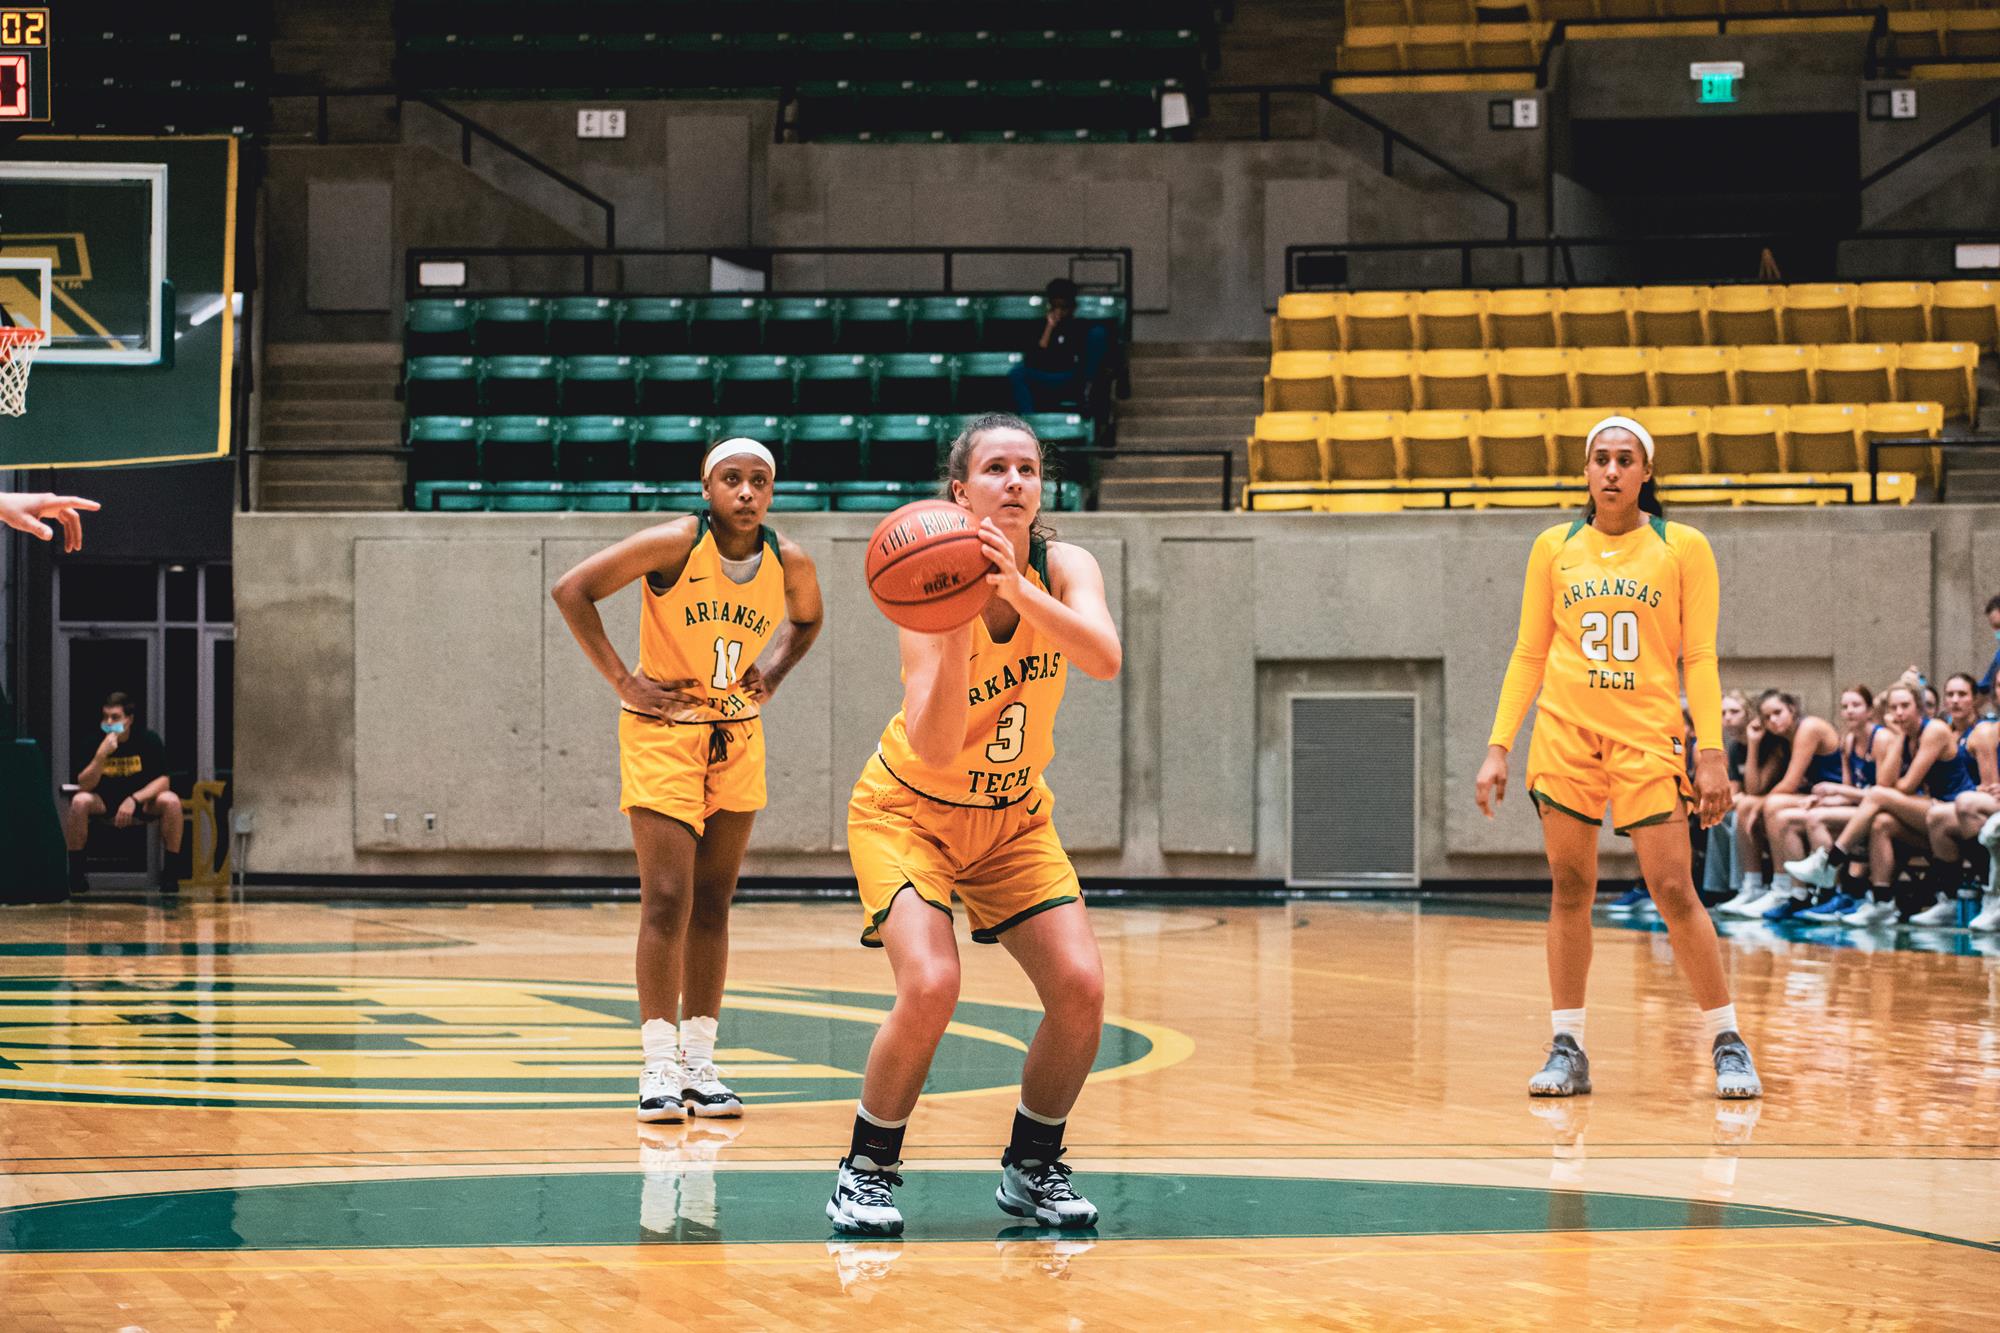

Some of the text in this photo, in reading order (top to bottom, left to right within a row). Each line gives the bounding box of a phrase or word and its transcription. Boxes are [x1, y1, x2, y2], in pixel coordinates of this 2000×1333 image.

[1563, 578, 1662, 609] ARKANSAS
[1580, 611, 1640, 662] 20
[711, 636, 743, 690] 11
[968, 652, 1061, 706] RKANSAS
[1588, 669, 1635, 691] TECH
[985, 702, 1027, 763] 3
[968, 766, 1031, 794] TECH
